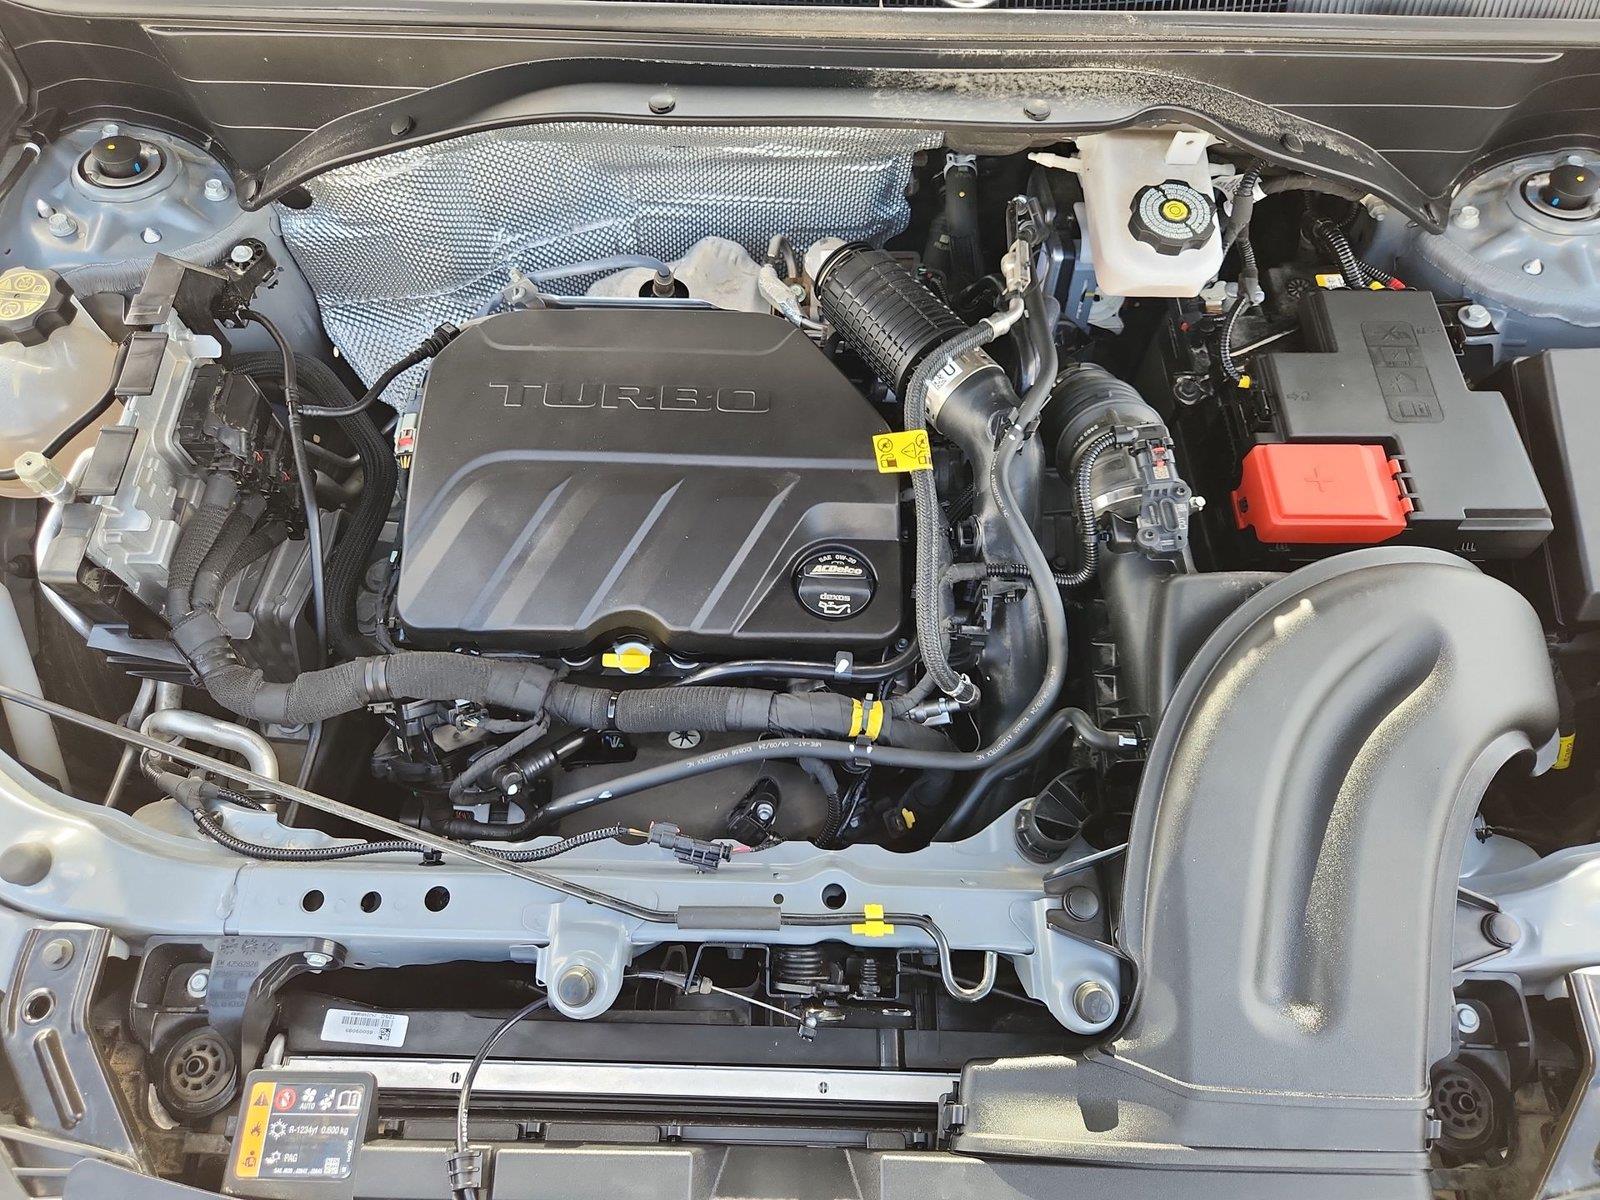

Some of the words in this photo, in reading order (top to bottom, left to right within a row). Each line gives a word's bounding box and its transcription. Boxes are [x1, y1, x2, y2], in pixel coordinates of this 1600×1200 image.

[489, 382, 770, 412] TURBO
[818, 554, 832, 563] SAE
[834, 554, 857, 564] 0W-20
[810, 564, 863, 575] ACDelco
[820, 592, 851, 602] dexos
[299, 1102, 316, 1110] AUTO
[340, 1126, 349, 1136] kg
[283, 1153, 298, 1162] PAG
